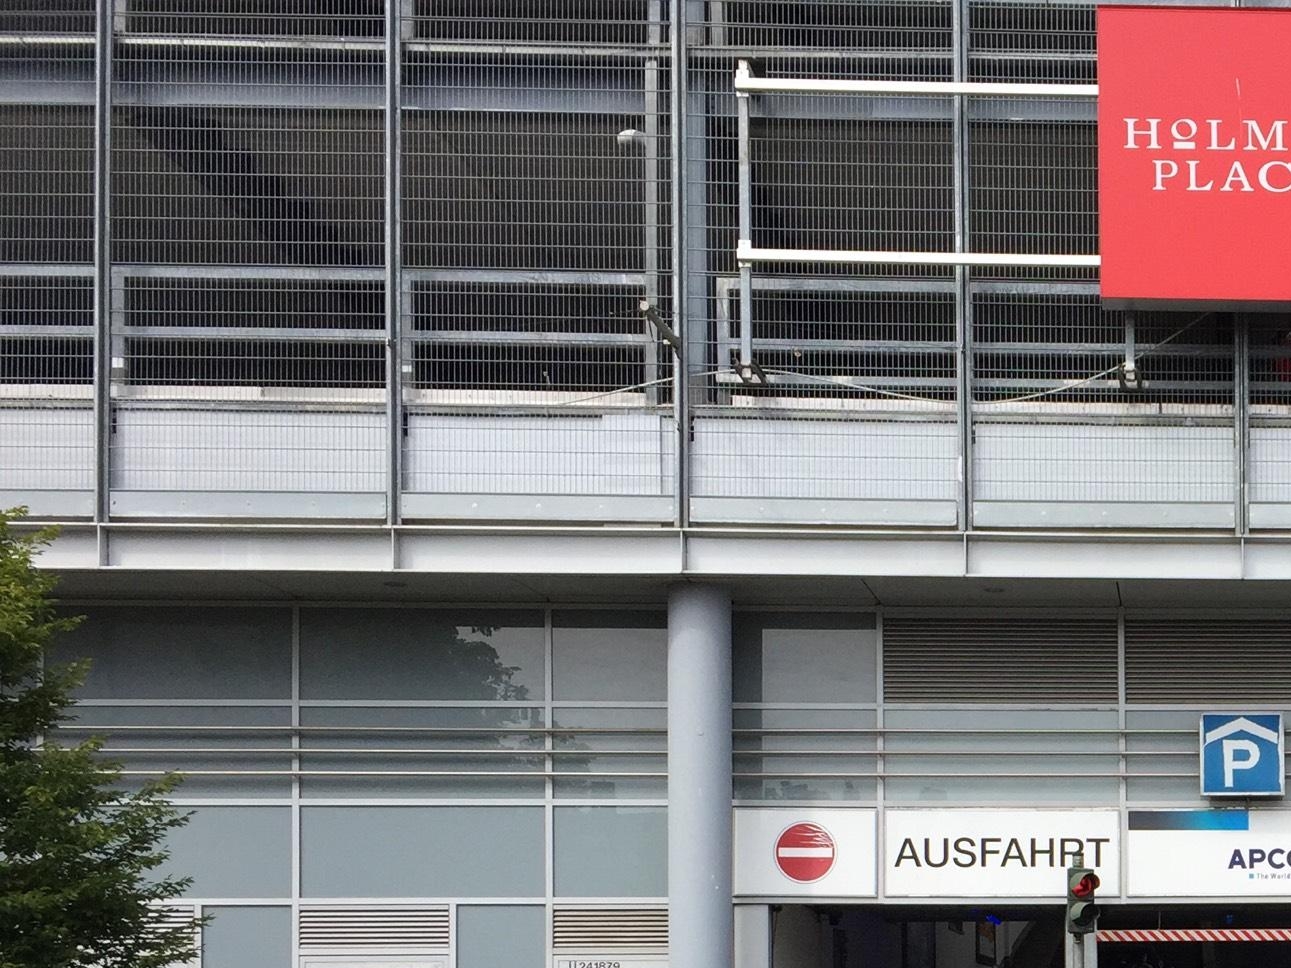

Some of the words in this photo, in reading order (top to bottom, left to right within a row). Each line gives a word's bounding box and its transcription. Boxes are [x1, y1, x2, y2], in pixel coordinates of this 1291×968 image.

[1222, 739, 1261, 788] P
[894, 837, 1110, 868] AUSFAHRT
[1256, 872, 1269, 880] The
[1270, 872, 1291, 880] World
